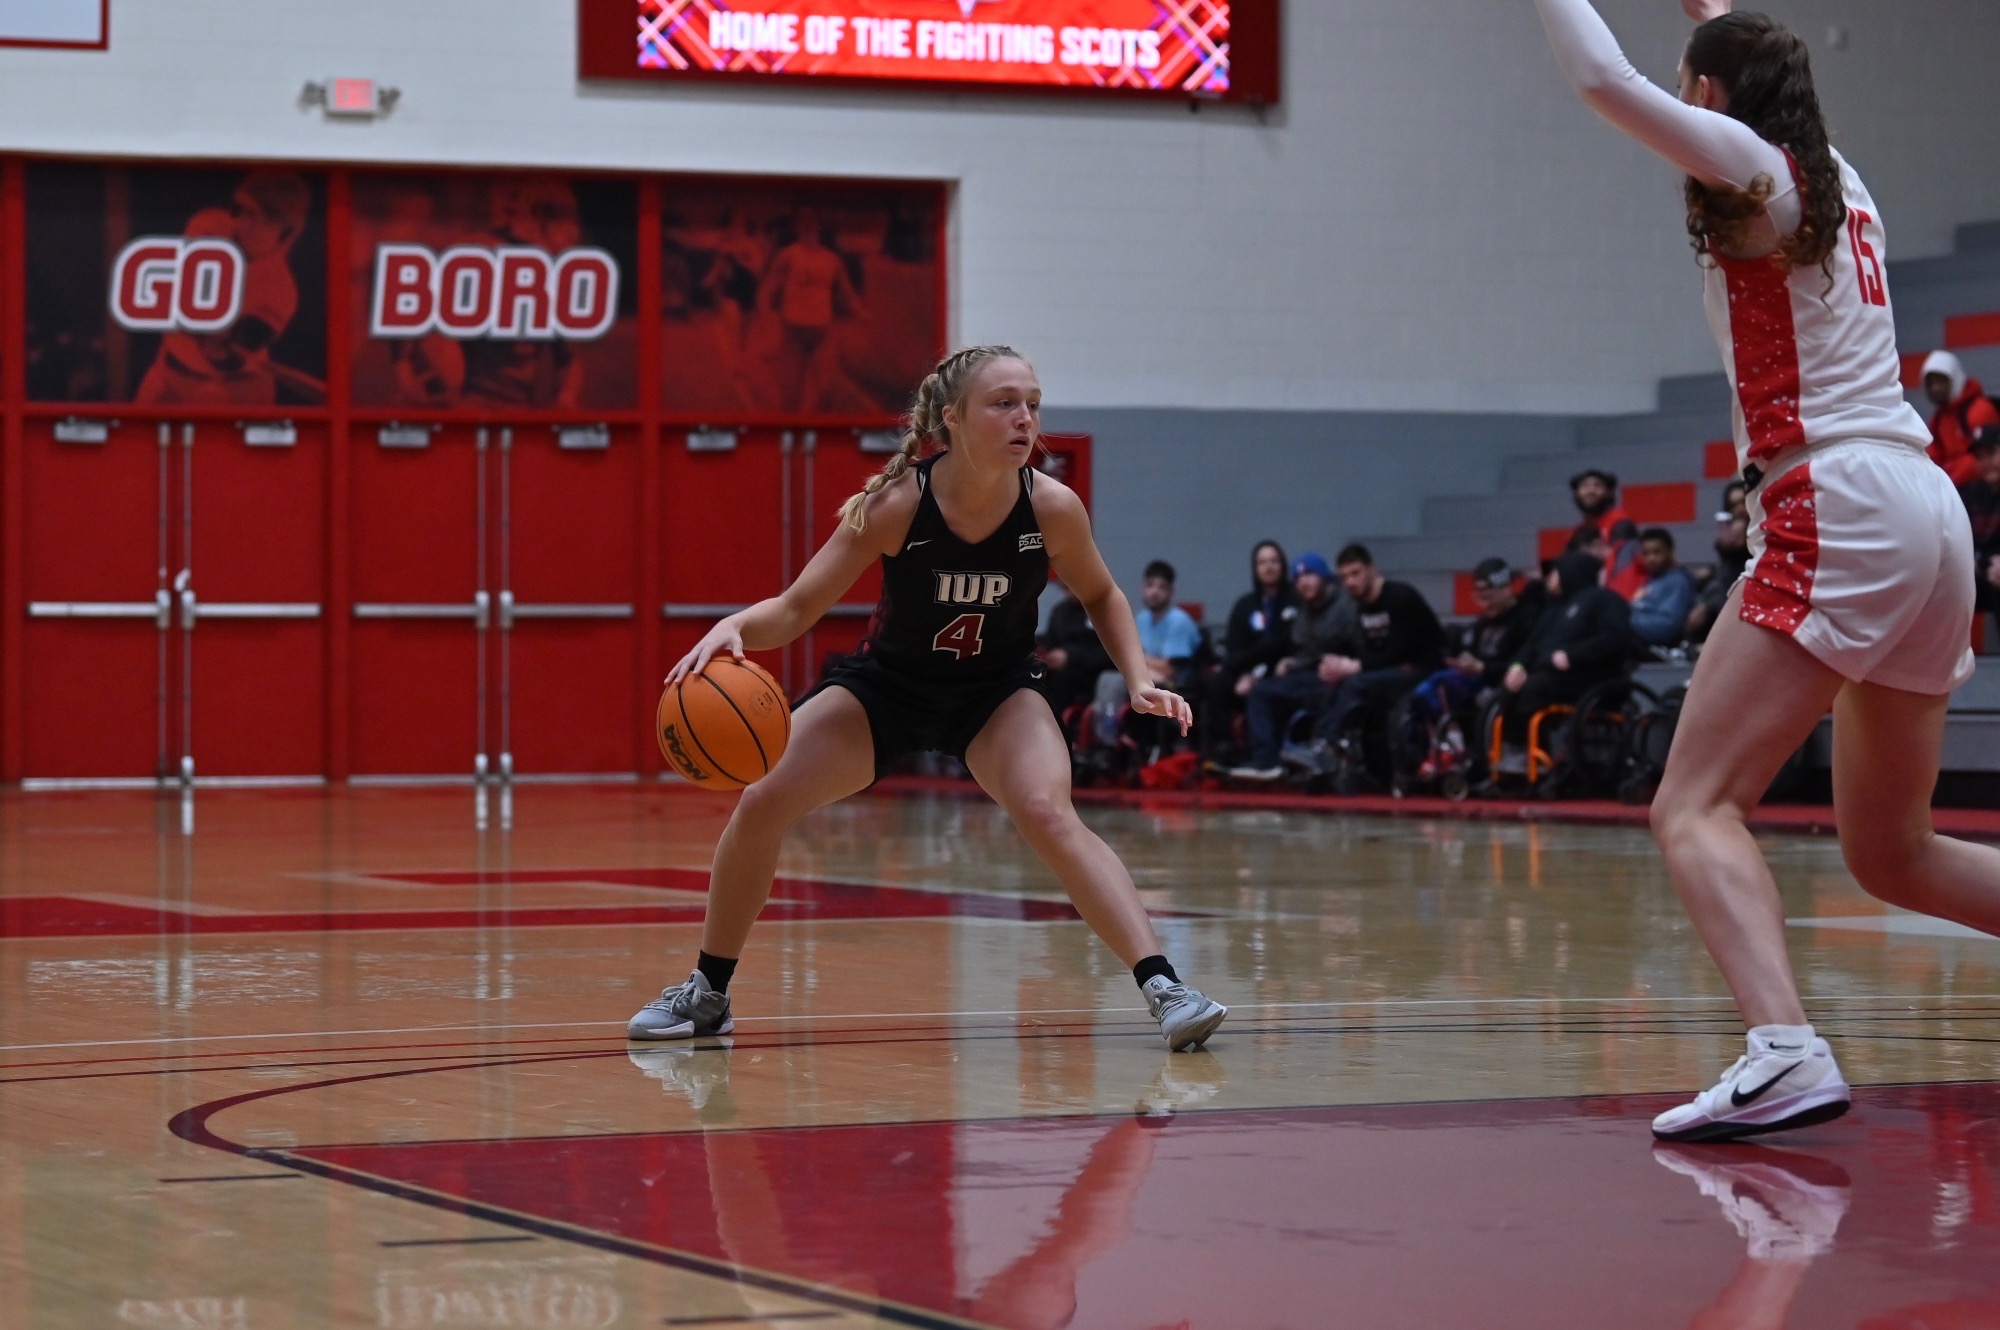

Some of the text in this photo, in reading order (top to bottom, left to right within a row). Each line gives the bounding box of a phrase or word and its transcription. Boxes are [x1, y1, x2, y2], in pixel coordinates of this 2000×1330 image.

[709, 10, 1160, 69] HOME OF THE FIGHTING SCOTS
[1846, 206, 1886, 306] 15
[111, 237, 619, 338] GO BORO
[1018, 536, 1043, 548] PSAC
[934, 571, 1011, 606] IUP
[932, 613, 985, 660] 4
